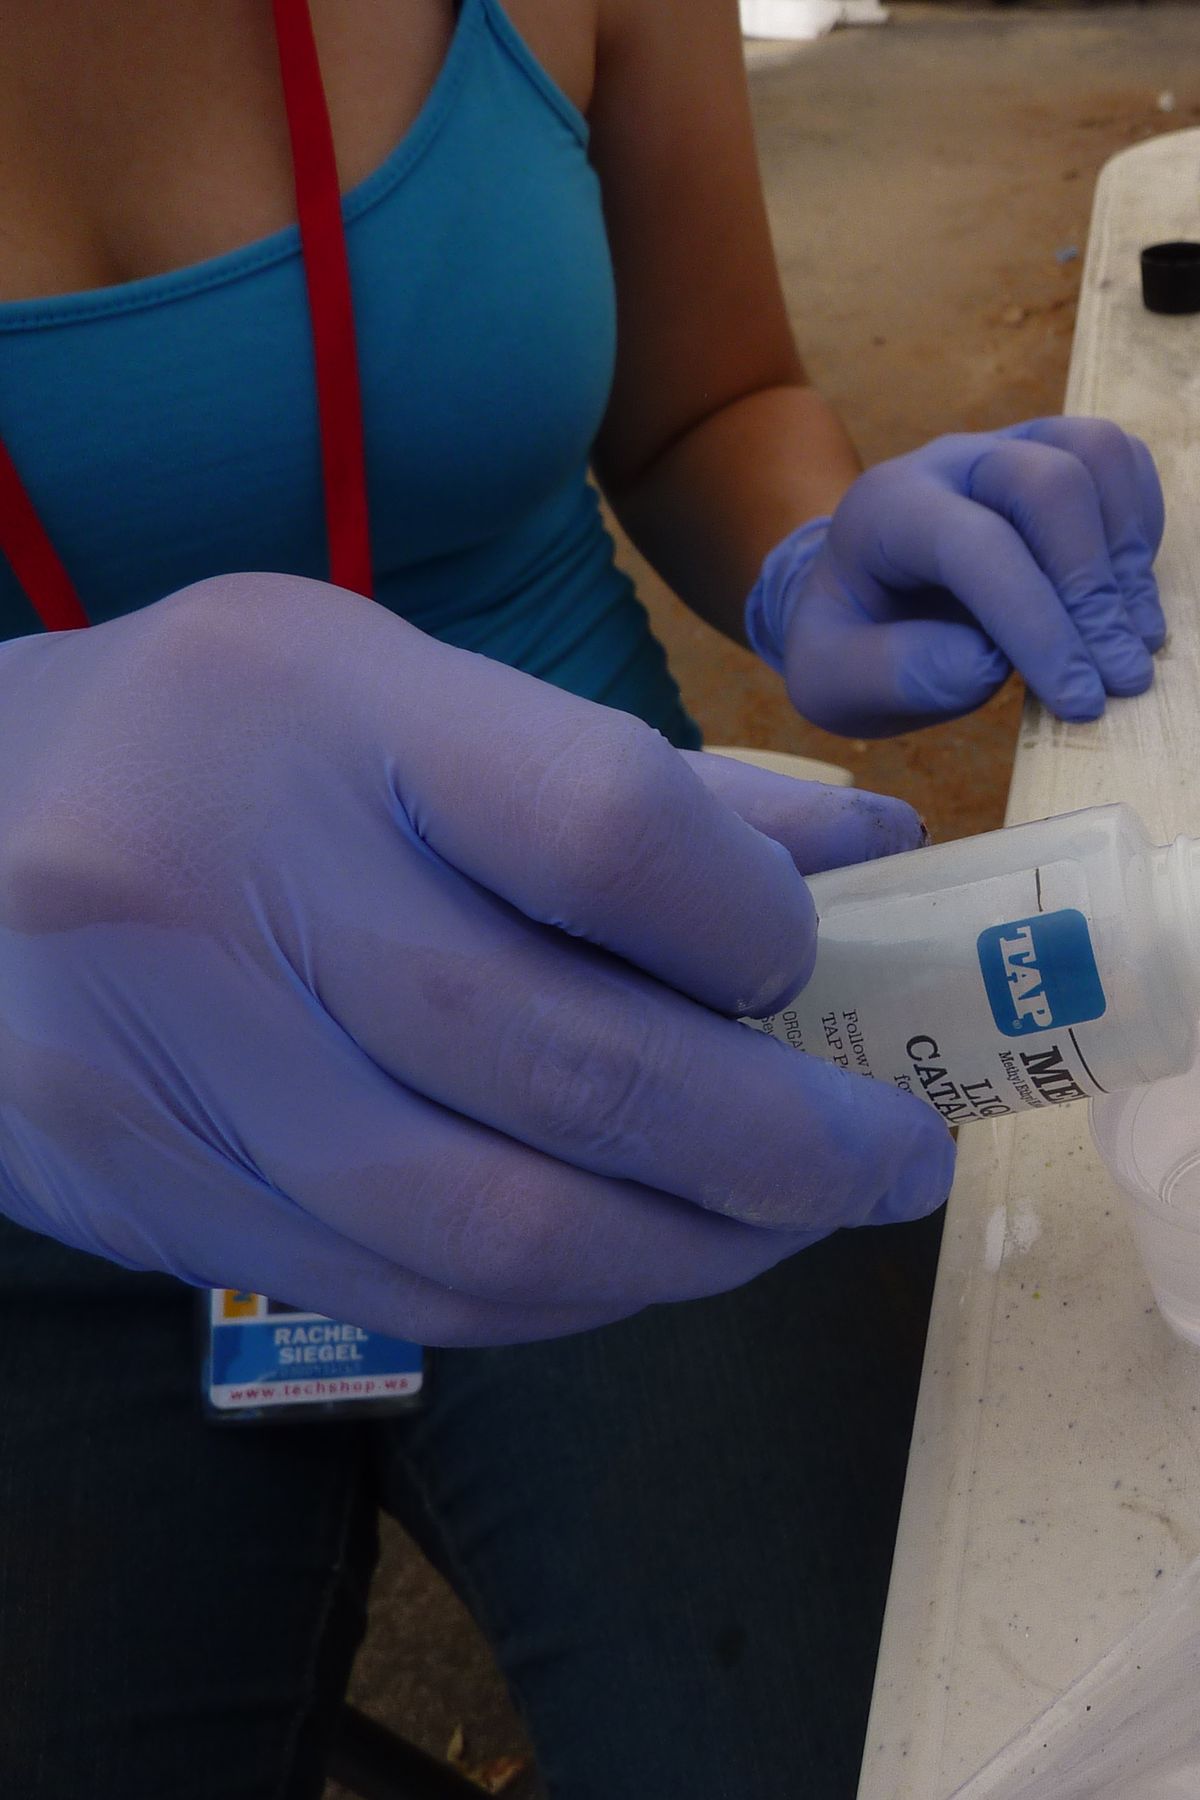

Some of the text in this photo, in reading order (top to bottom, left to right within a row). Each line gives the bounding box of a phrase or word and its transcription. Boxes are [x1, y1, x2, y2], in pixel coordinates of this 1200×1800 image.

[1000, 925, 1053, 1029] TAP
[782, 1010, 806, 1052] ORGA
[821, 1011, 843, 1050] TAP
[842, 1008, 870, 1068] Follow
[906, 1034, 981, 1125] CATAL
[998, 1050, 1025, 1085] Methyl
[1019, 1044, 1084, 1104] ME
[960, 1078, 1014, 1118] LIQ
[273, 1325, 368, 1345] RACHEL
[279, 1344, 363, 1363] SIEGEL
